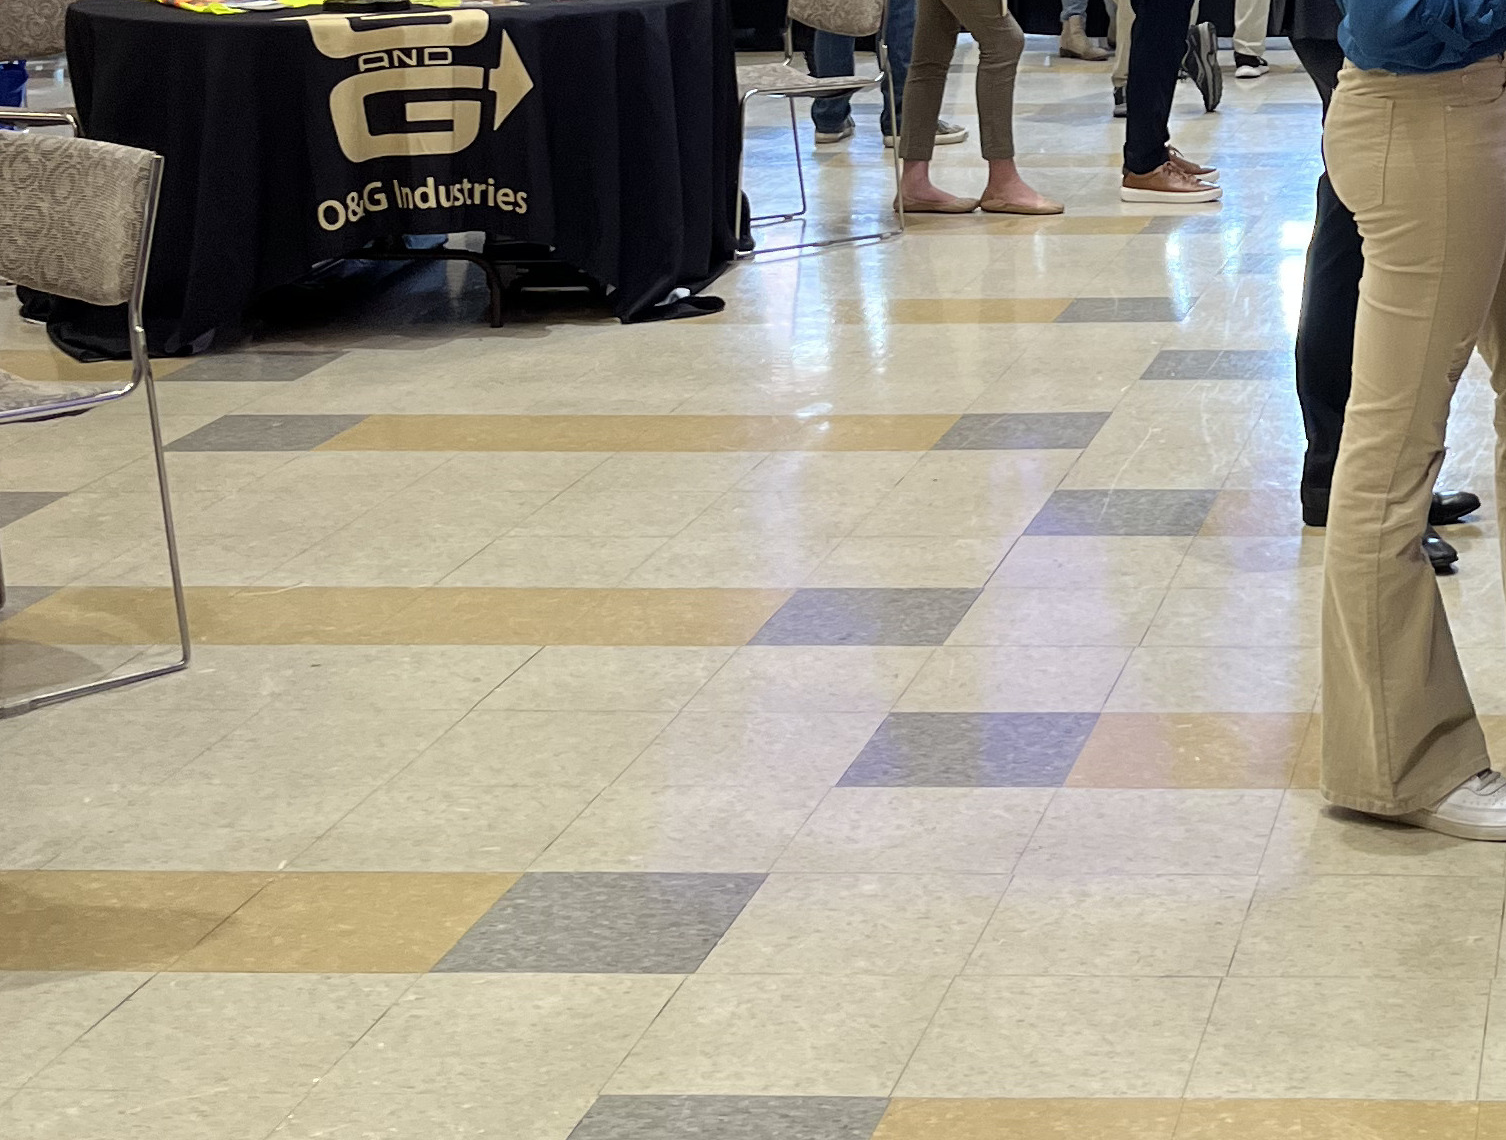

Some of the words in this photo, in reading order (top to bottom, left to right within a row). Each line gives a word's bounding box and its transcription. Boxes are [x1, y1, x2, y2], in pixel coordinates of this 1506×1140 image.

[358, 47, 453, 72] AND
[317, 181, 389, 231] O&G
[393, 176, 528, 214] Industries
